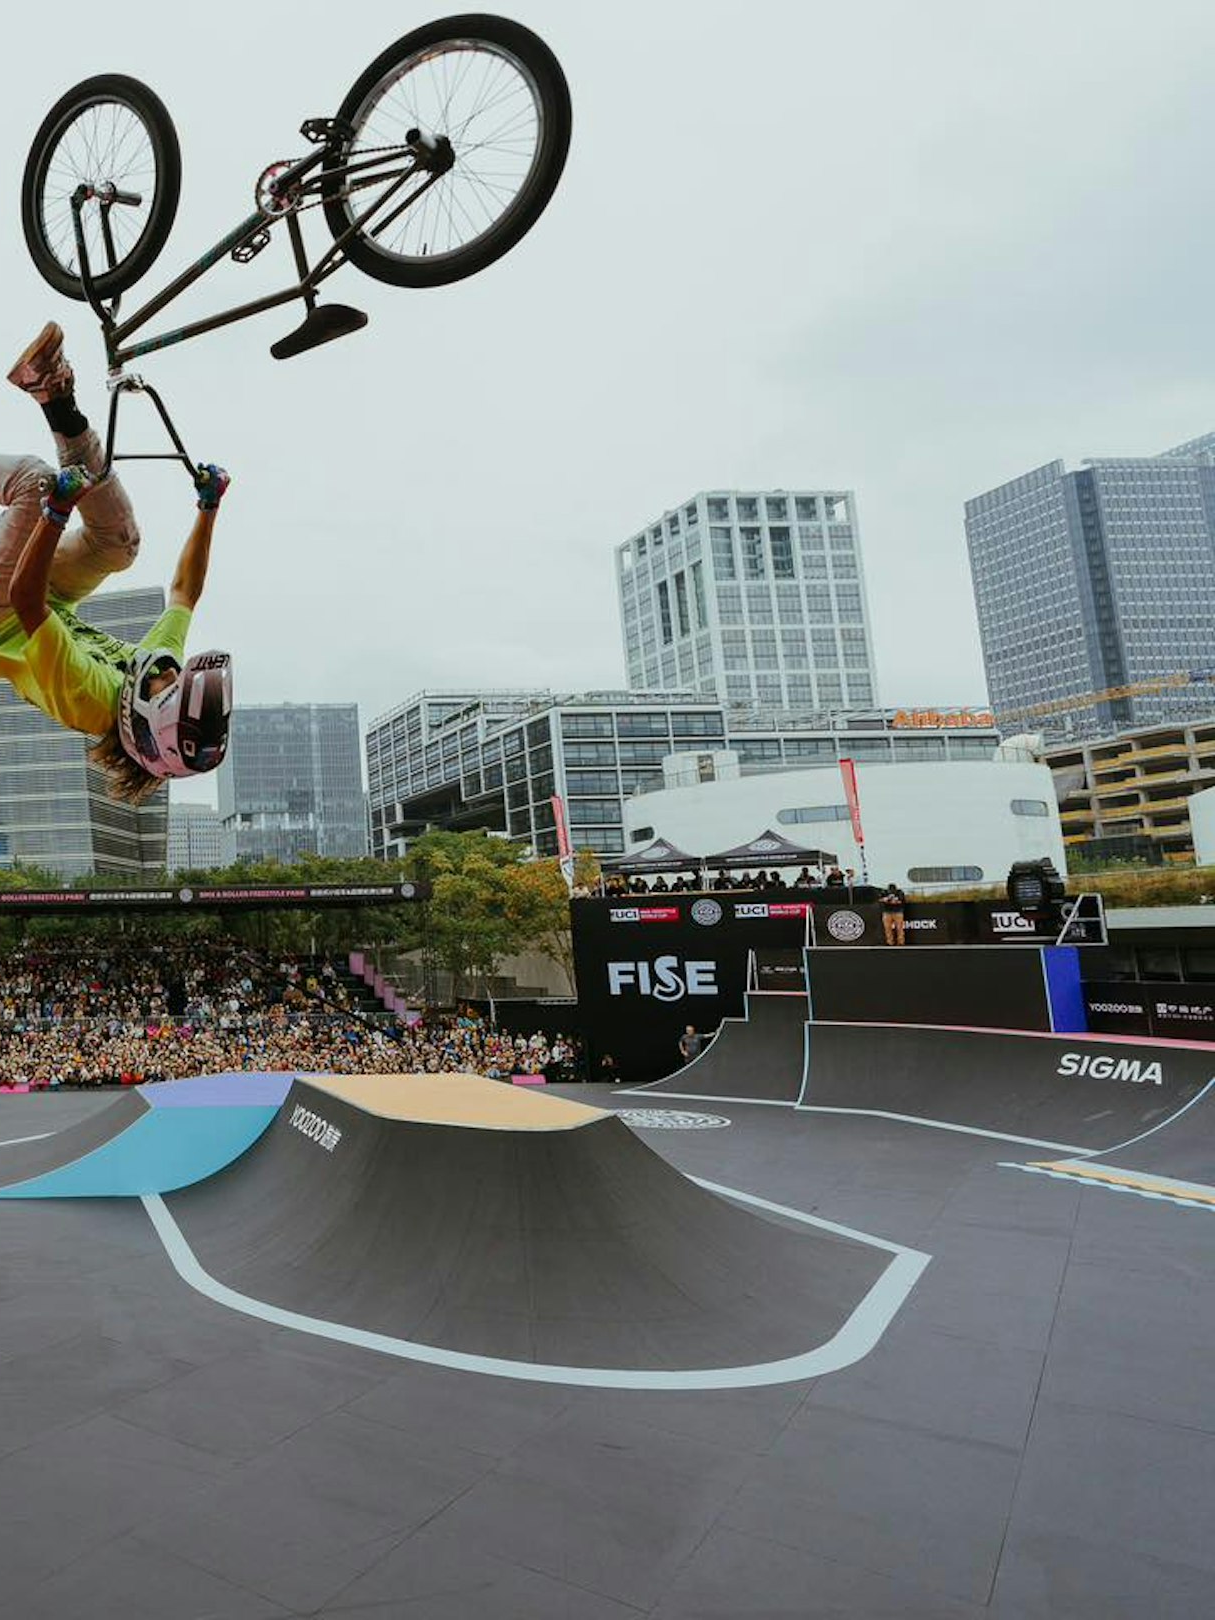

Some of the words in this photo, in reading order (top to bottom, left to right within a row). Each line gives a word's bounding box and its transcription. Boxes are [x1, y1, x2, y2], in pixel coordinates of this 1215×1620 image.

[190, 653, 230, 671] LEATT
[615, 911, 637, 919] UCI
[741, 906, 765, 915] UCI
[607, 955, 718, 1001] FISE
[1057, 1052, 1163, 1086] SIGMA
[289, 1103, 328, 1142] YOOZOO
